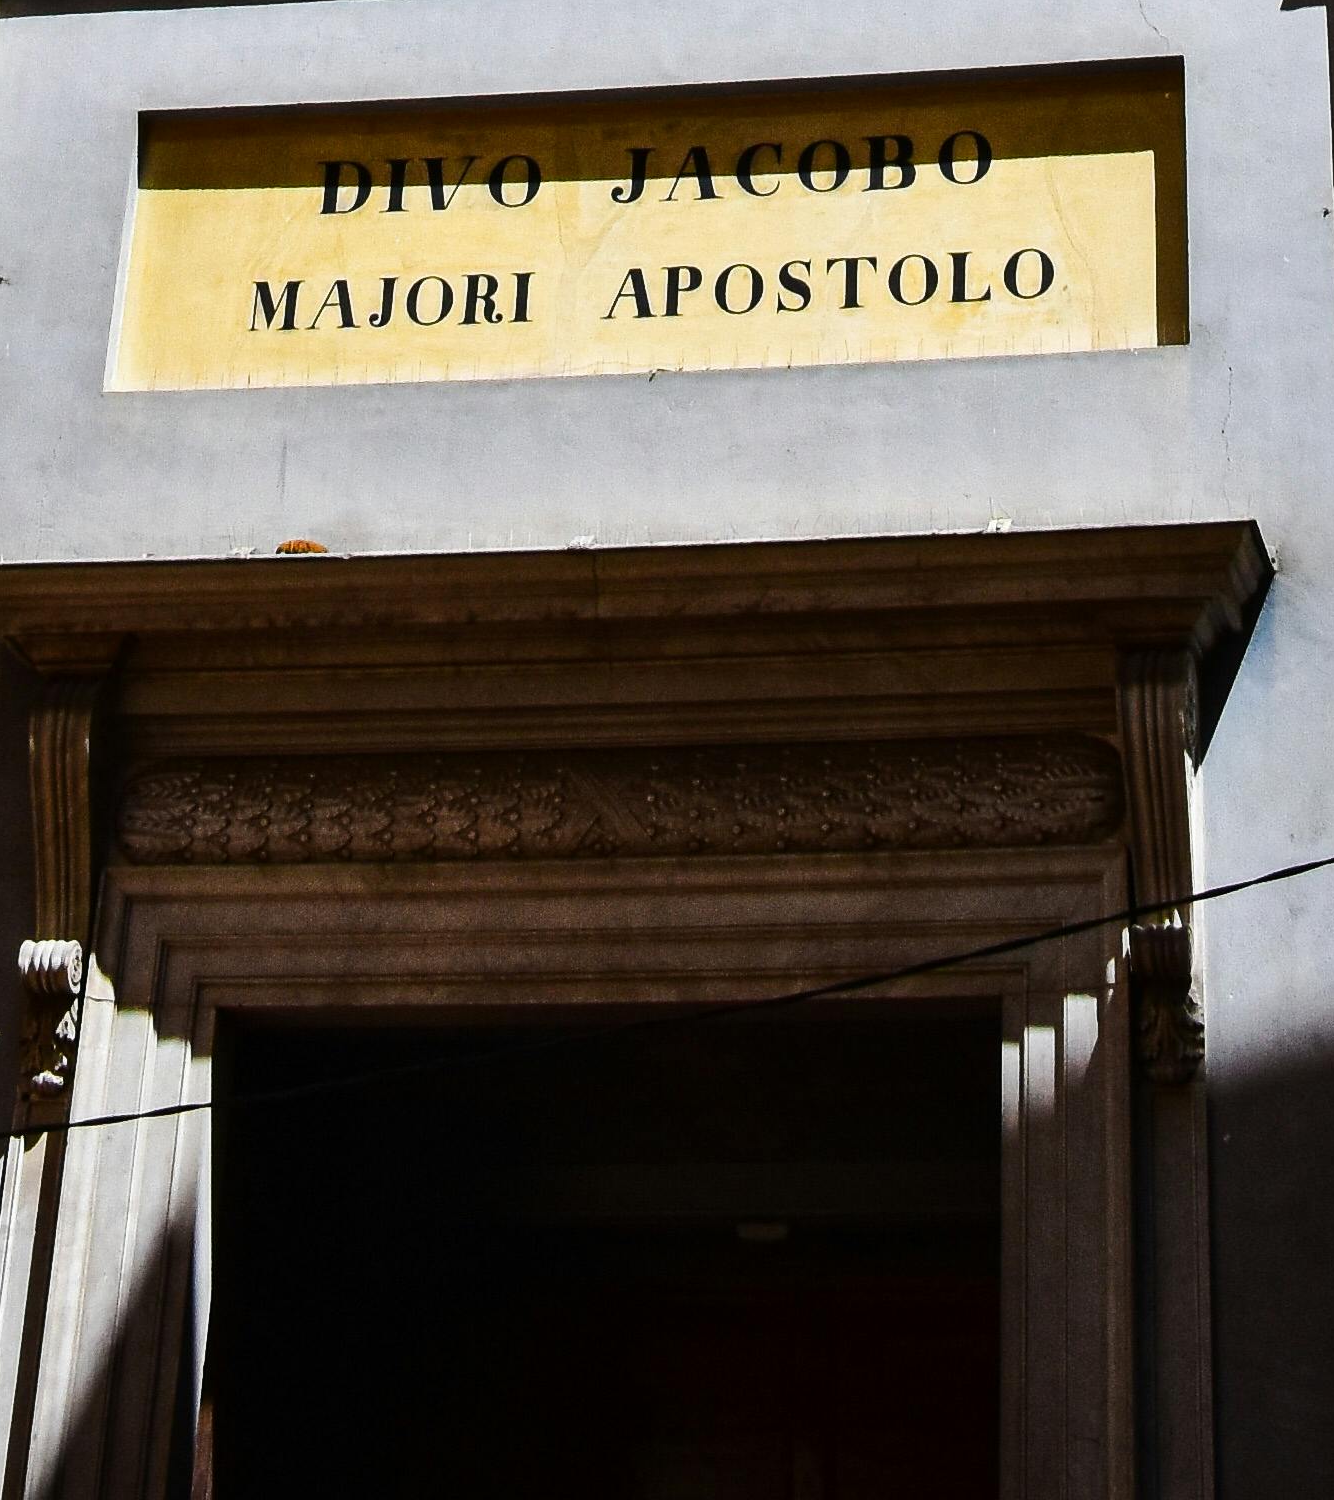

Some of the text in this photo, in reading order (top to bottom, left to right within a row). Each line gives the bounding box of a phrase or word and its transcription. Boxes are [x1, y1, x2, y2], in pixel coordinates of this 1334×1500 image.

[317, 130, 993, 214] DIVO JACOBO
[248, 248, 1055, 332] MAJORI APOSTOLO
